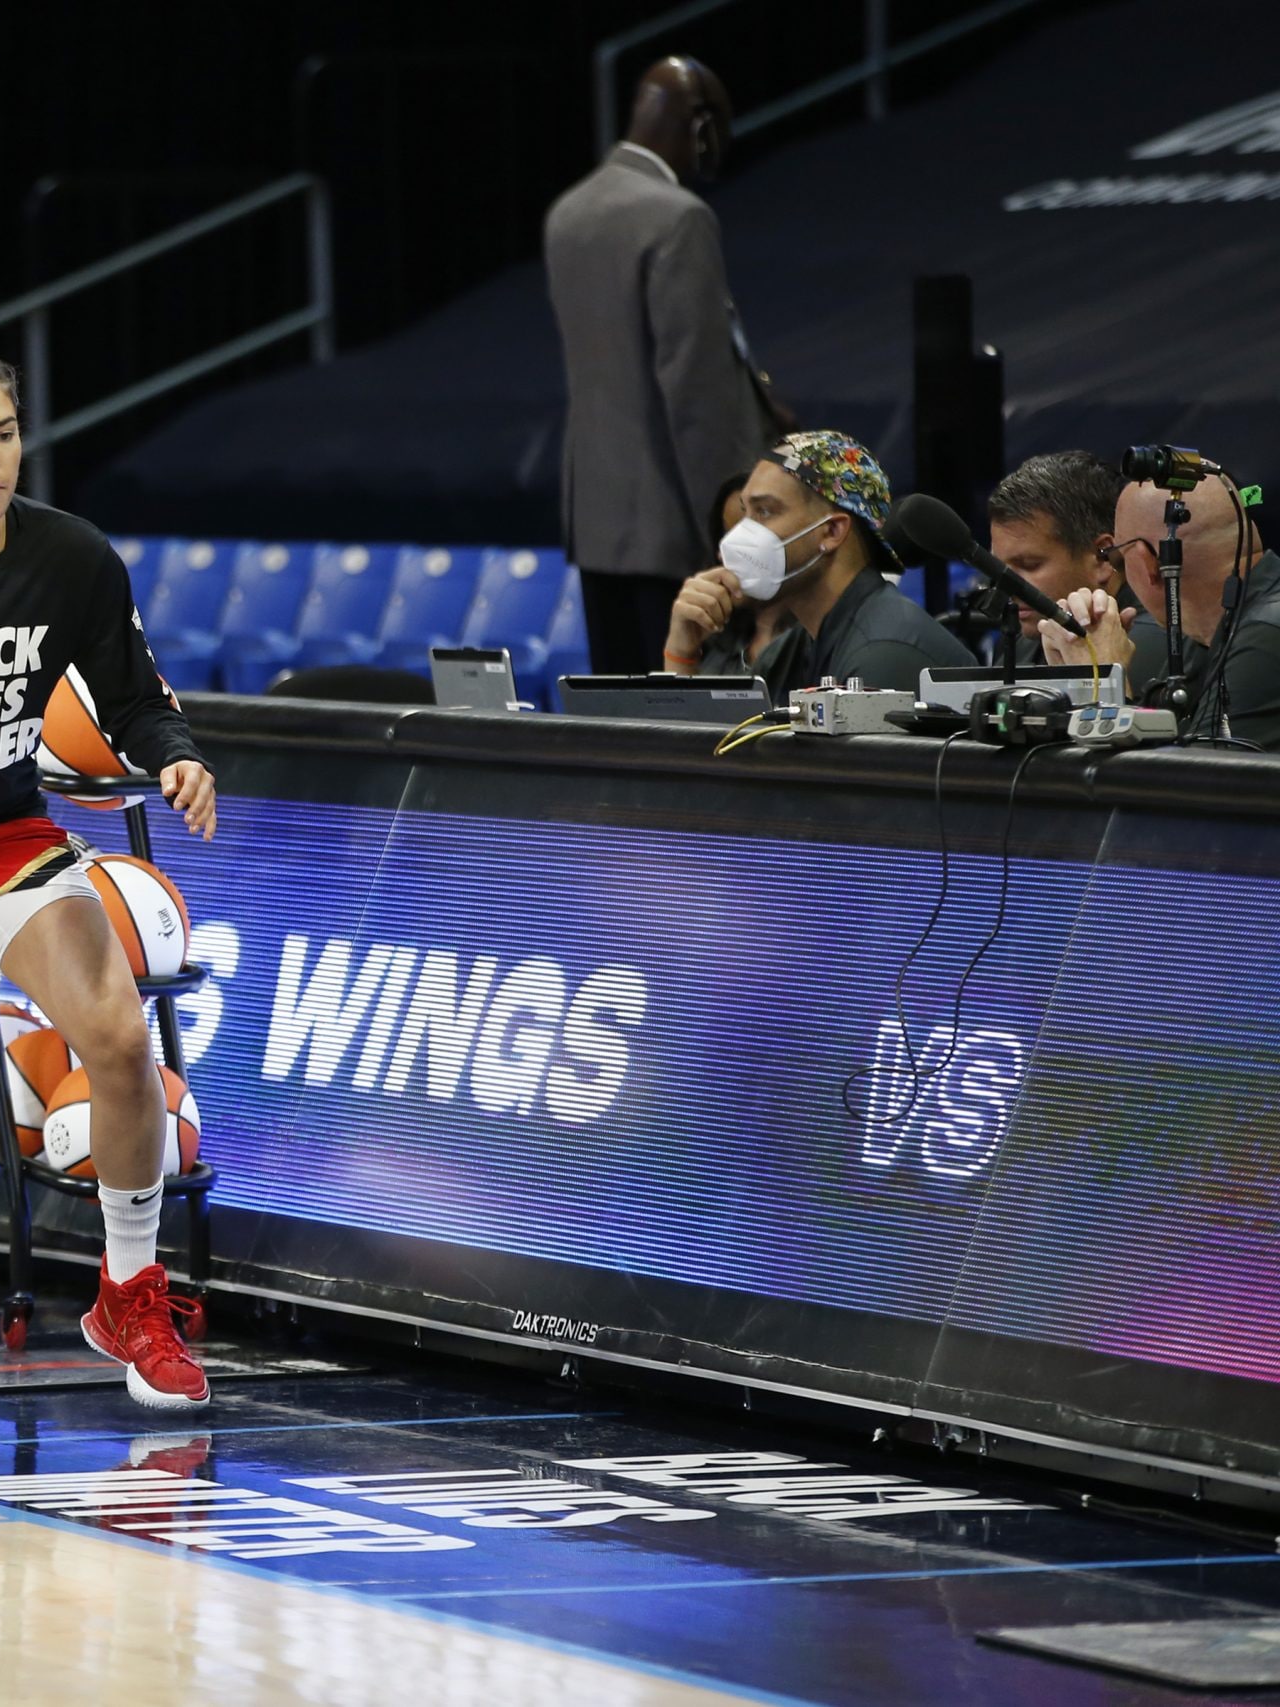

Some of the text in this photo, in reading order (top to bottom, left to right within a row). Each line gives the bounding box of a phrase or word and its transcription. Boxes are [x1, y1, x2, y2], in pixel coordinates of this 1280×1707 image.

[261, 934, 647, 1123] WINGS
[860, 1019, 1022, 1176] VS
[512, 1309, 599, 1343] DAKTRONICS
[280, 1469, 718, 1528] LIVES
[554, 1451, 1061, 1521] BLACK
